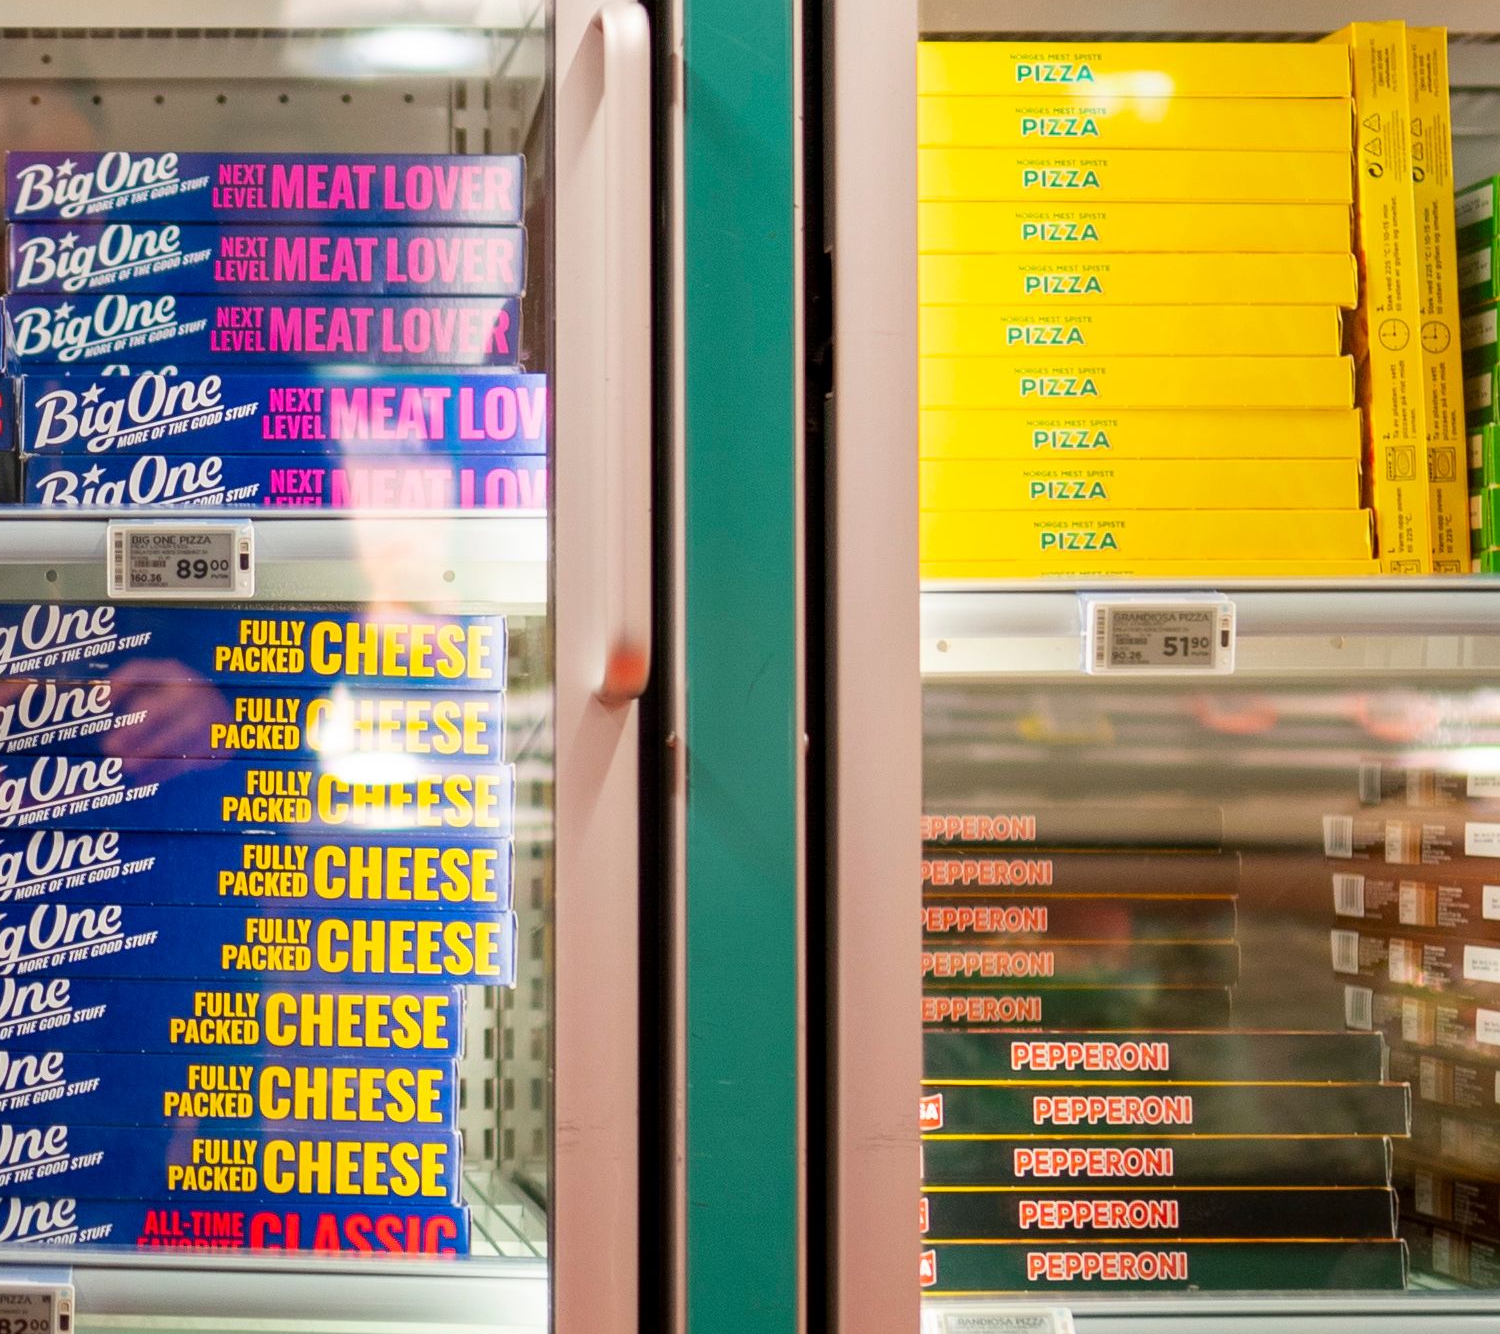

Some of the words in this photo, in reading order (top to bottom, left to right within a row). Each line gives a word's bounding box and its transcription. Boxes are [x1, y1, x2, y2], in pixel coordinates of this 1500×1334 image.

[1009, 53, 1044, 61] NORGES
[1048, 53, 1072, 61] MEST
[1075, 53, 1102, 61] SPISTE
[1016, 64, 1094, 84] PIZZA
[218, 165, 266, 185] NEXT
[212, 187, 266, 209] LEVEL
[271, 165, 377, 210] MEAT
[384, 165, 512, 211] LOVER
[132, 535, 150, 545] BIG
[153, 535, 177, 545] ONE
[180, 535, 212, 545] PIZZA
[1175, 612, 1210, 623] PIZZA
[240, 619, 304, 645] FULLY
[215, 646, 304, 673] PACKED
[311, 621, 493, 679] CHEESE
[1011, 1042, 1169, 1070] PEPPERONI
